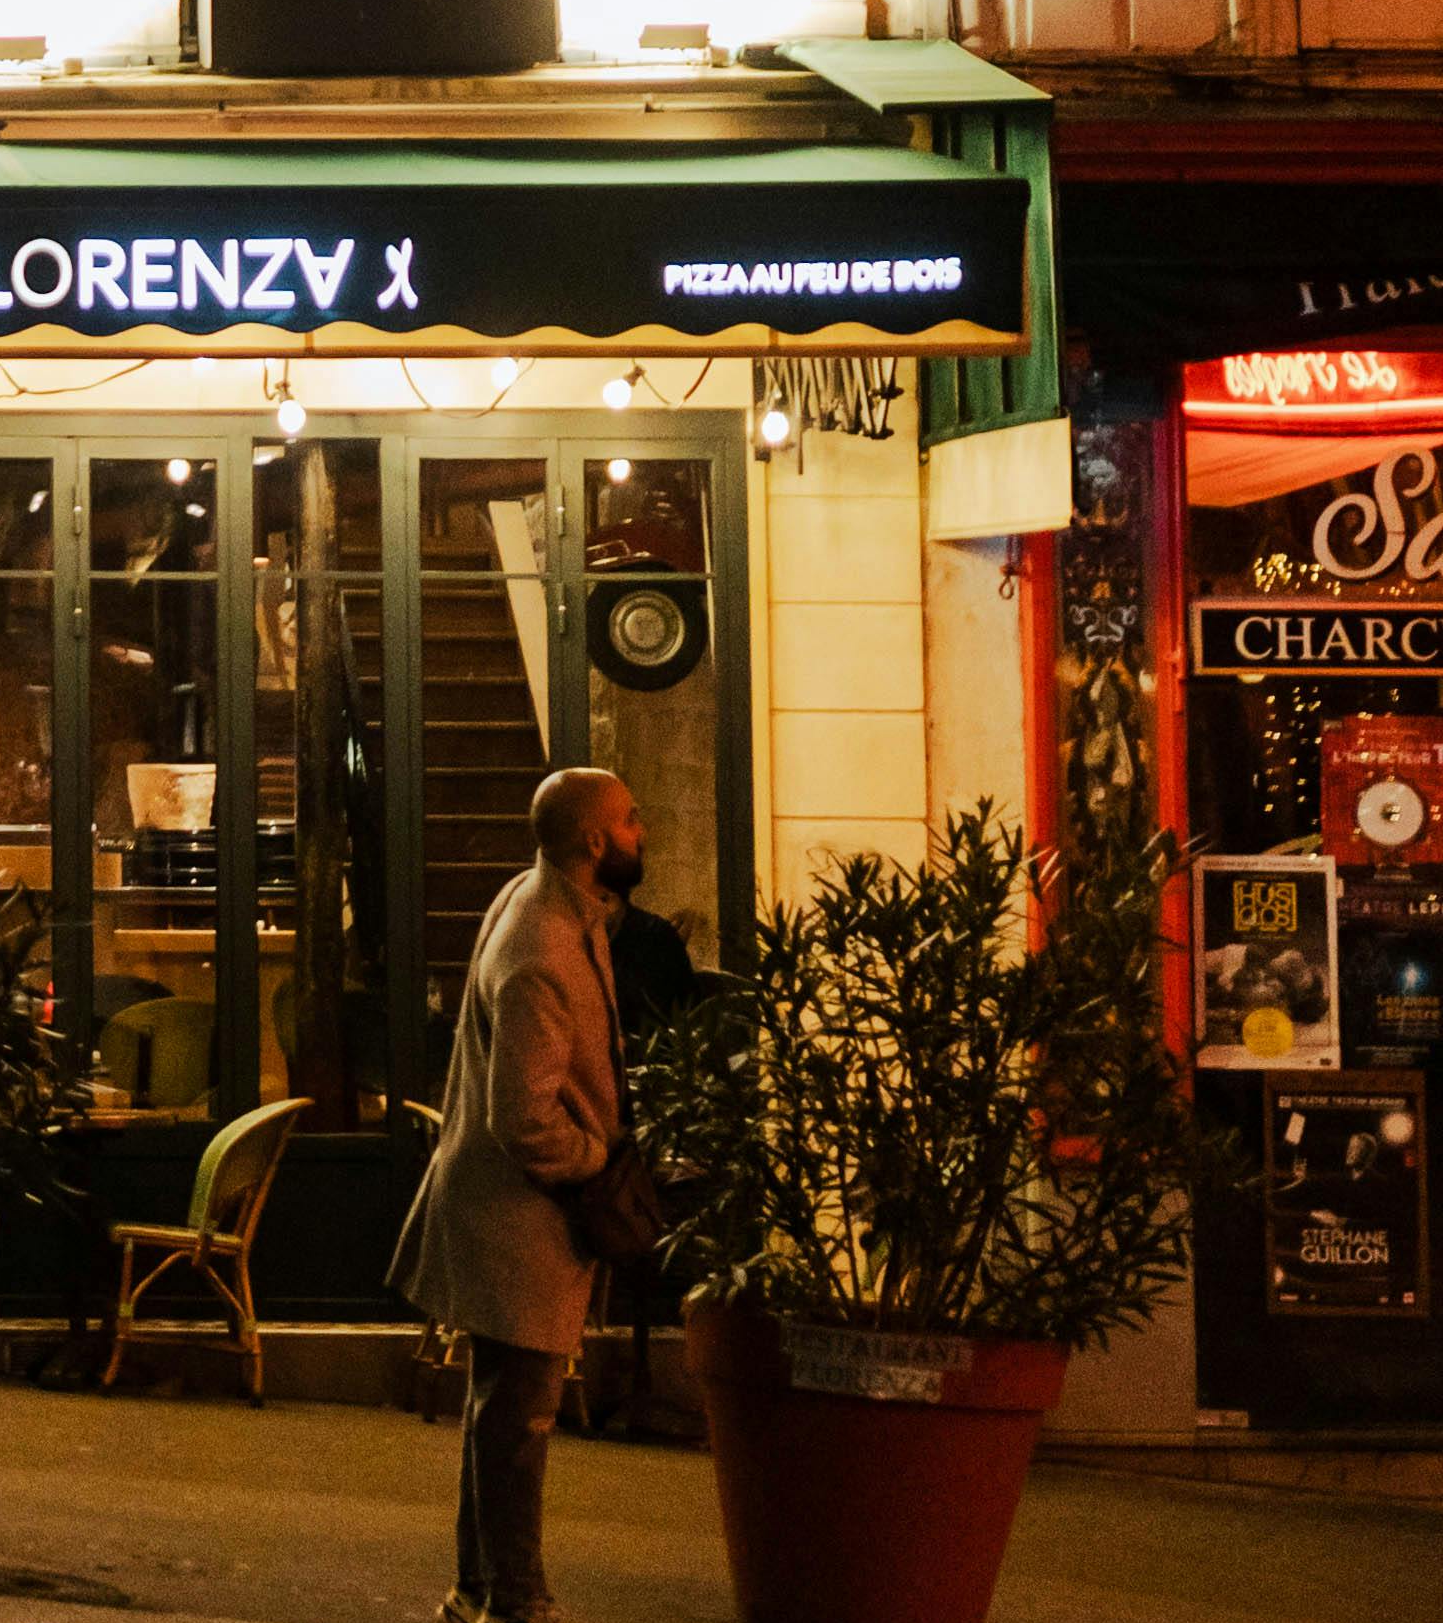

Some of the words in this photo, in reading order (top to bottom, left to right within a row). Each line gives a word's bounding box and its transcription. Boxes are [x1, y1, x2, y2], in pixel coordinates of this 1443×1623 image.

[664, 263, 749, 296] PIZZA
[749, 262, 793, 295] AU
[793, 261, 849, 295] FEU
[850, 260, 892, 293] DE
[893, 257, 963, 292] BOIS
[1298, 1245, 1389, 1265] GUILLON
